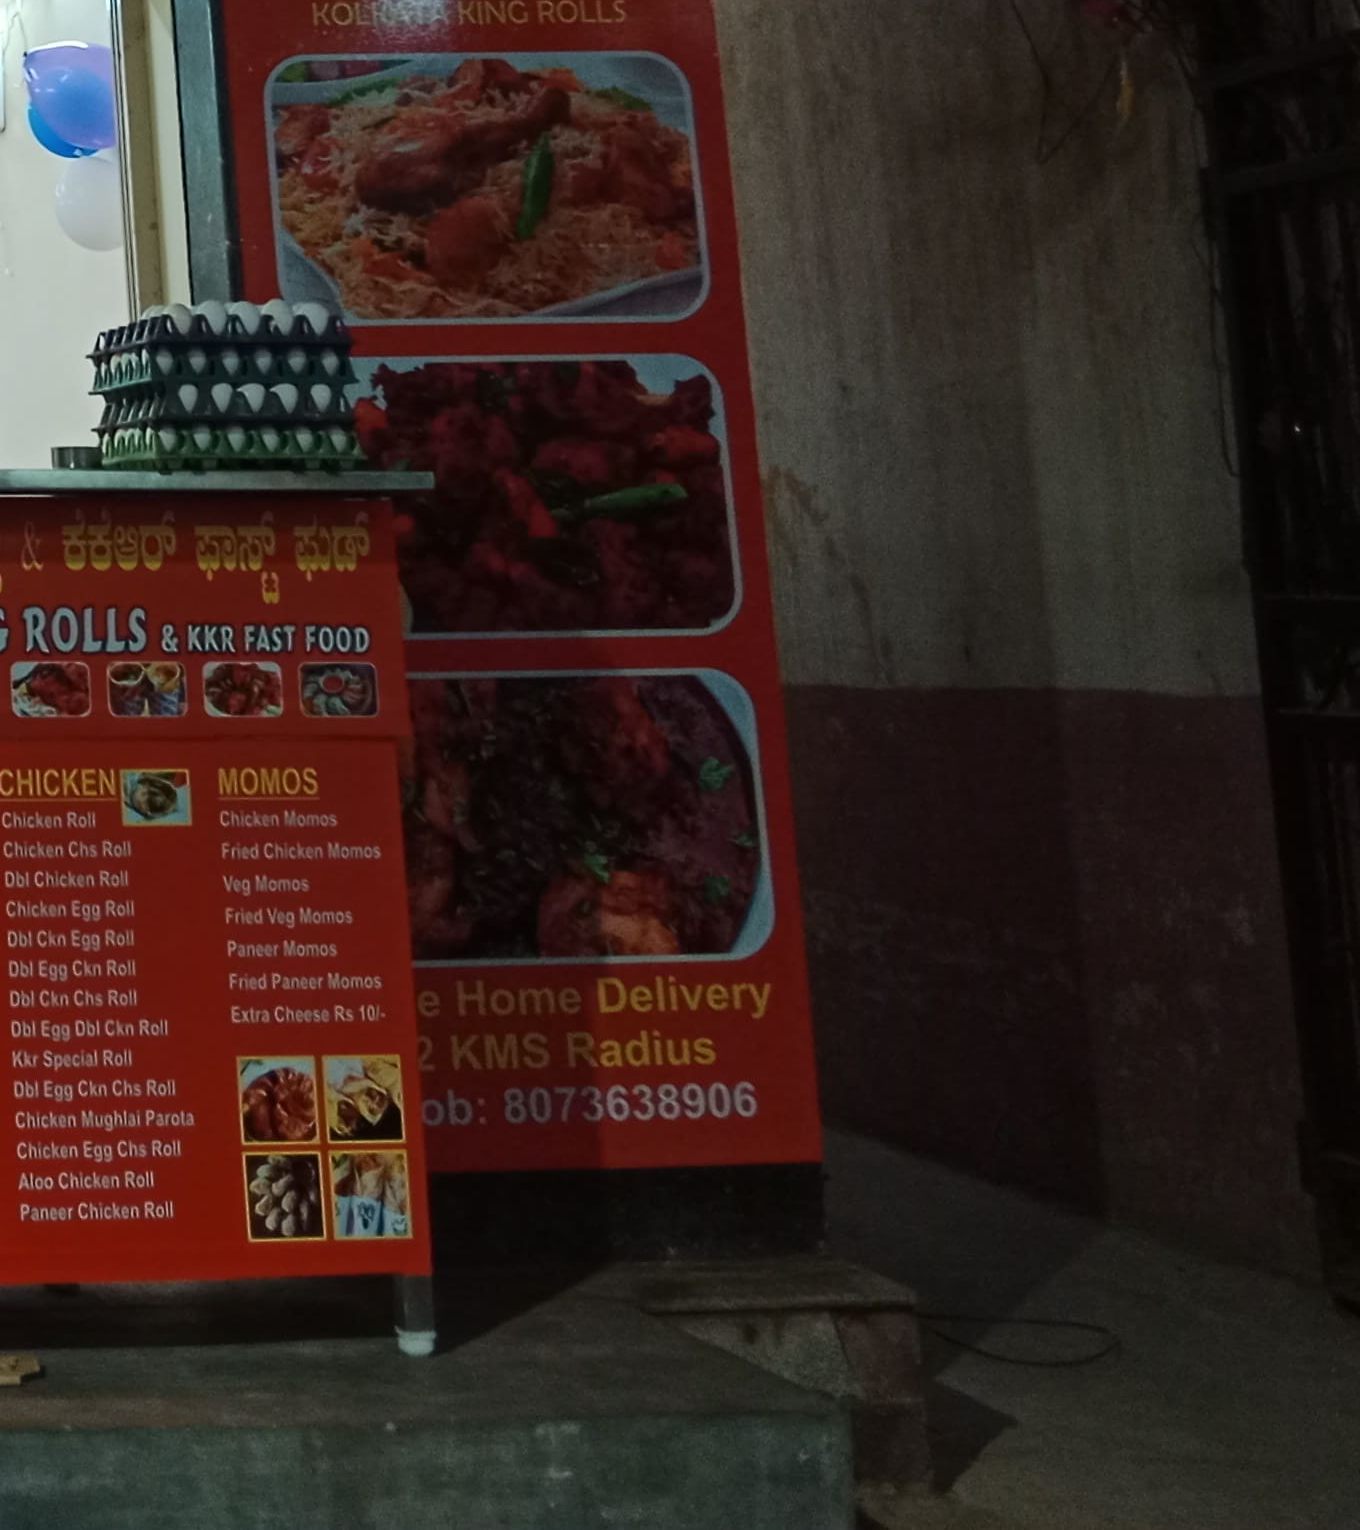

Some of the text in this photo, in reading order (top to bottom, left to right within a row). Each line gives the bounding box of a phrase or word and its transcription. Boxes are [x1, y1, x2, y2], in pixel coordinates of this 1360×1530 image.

[312, 0, 627, 27] KOLKATA KING ROLLS
[20, 528, 43, 572] &
[21, 605, 146, 652] ROLLS
[161, 624, 178, 652] &
[186, 623, 235, 652] KKR
[244, 623, 295, 653] FAST
[305, 623, 369, 654] FOOD
[218, 767, 318, 796] MOMOS
[219, 810, 338, 828] Chicken Momos
[222, 874, 310, 896] Veg Momos
[226, 940, 338, 958] Paneer Momos
[457, 980, 581, 1016] Home
[597, 976, 771, 1018] Delivery
[230, 1004, 386, 1024] Extra Cheese Rs 10/-
[417, 1031, 716, 1071] 2 KMS Radius
[421, 1082, 757, 1126] ob: 8073638906
